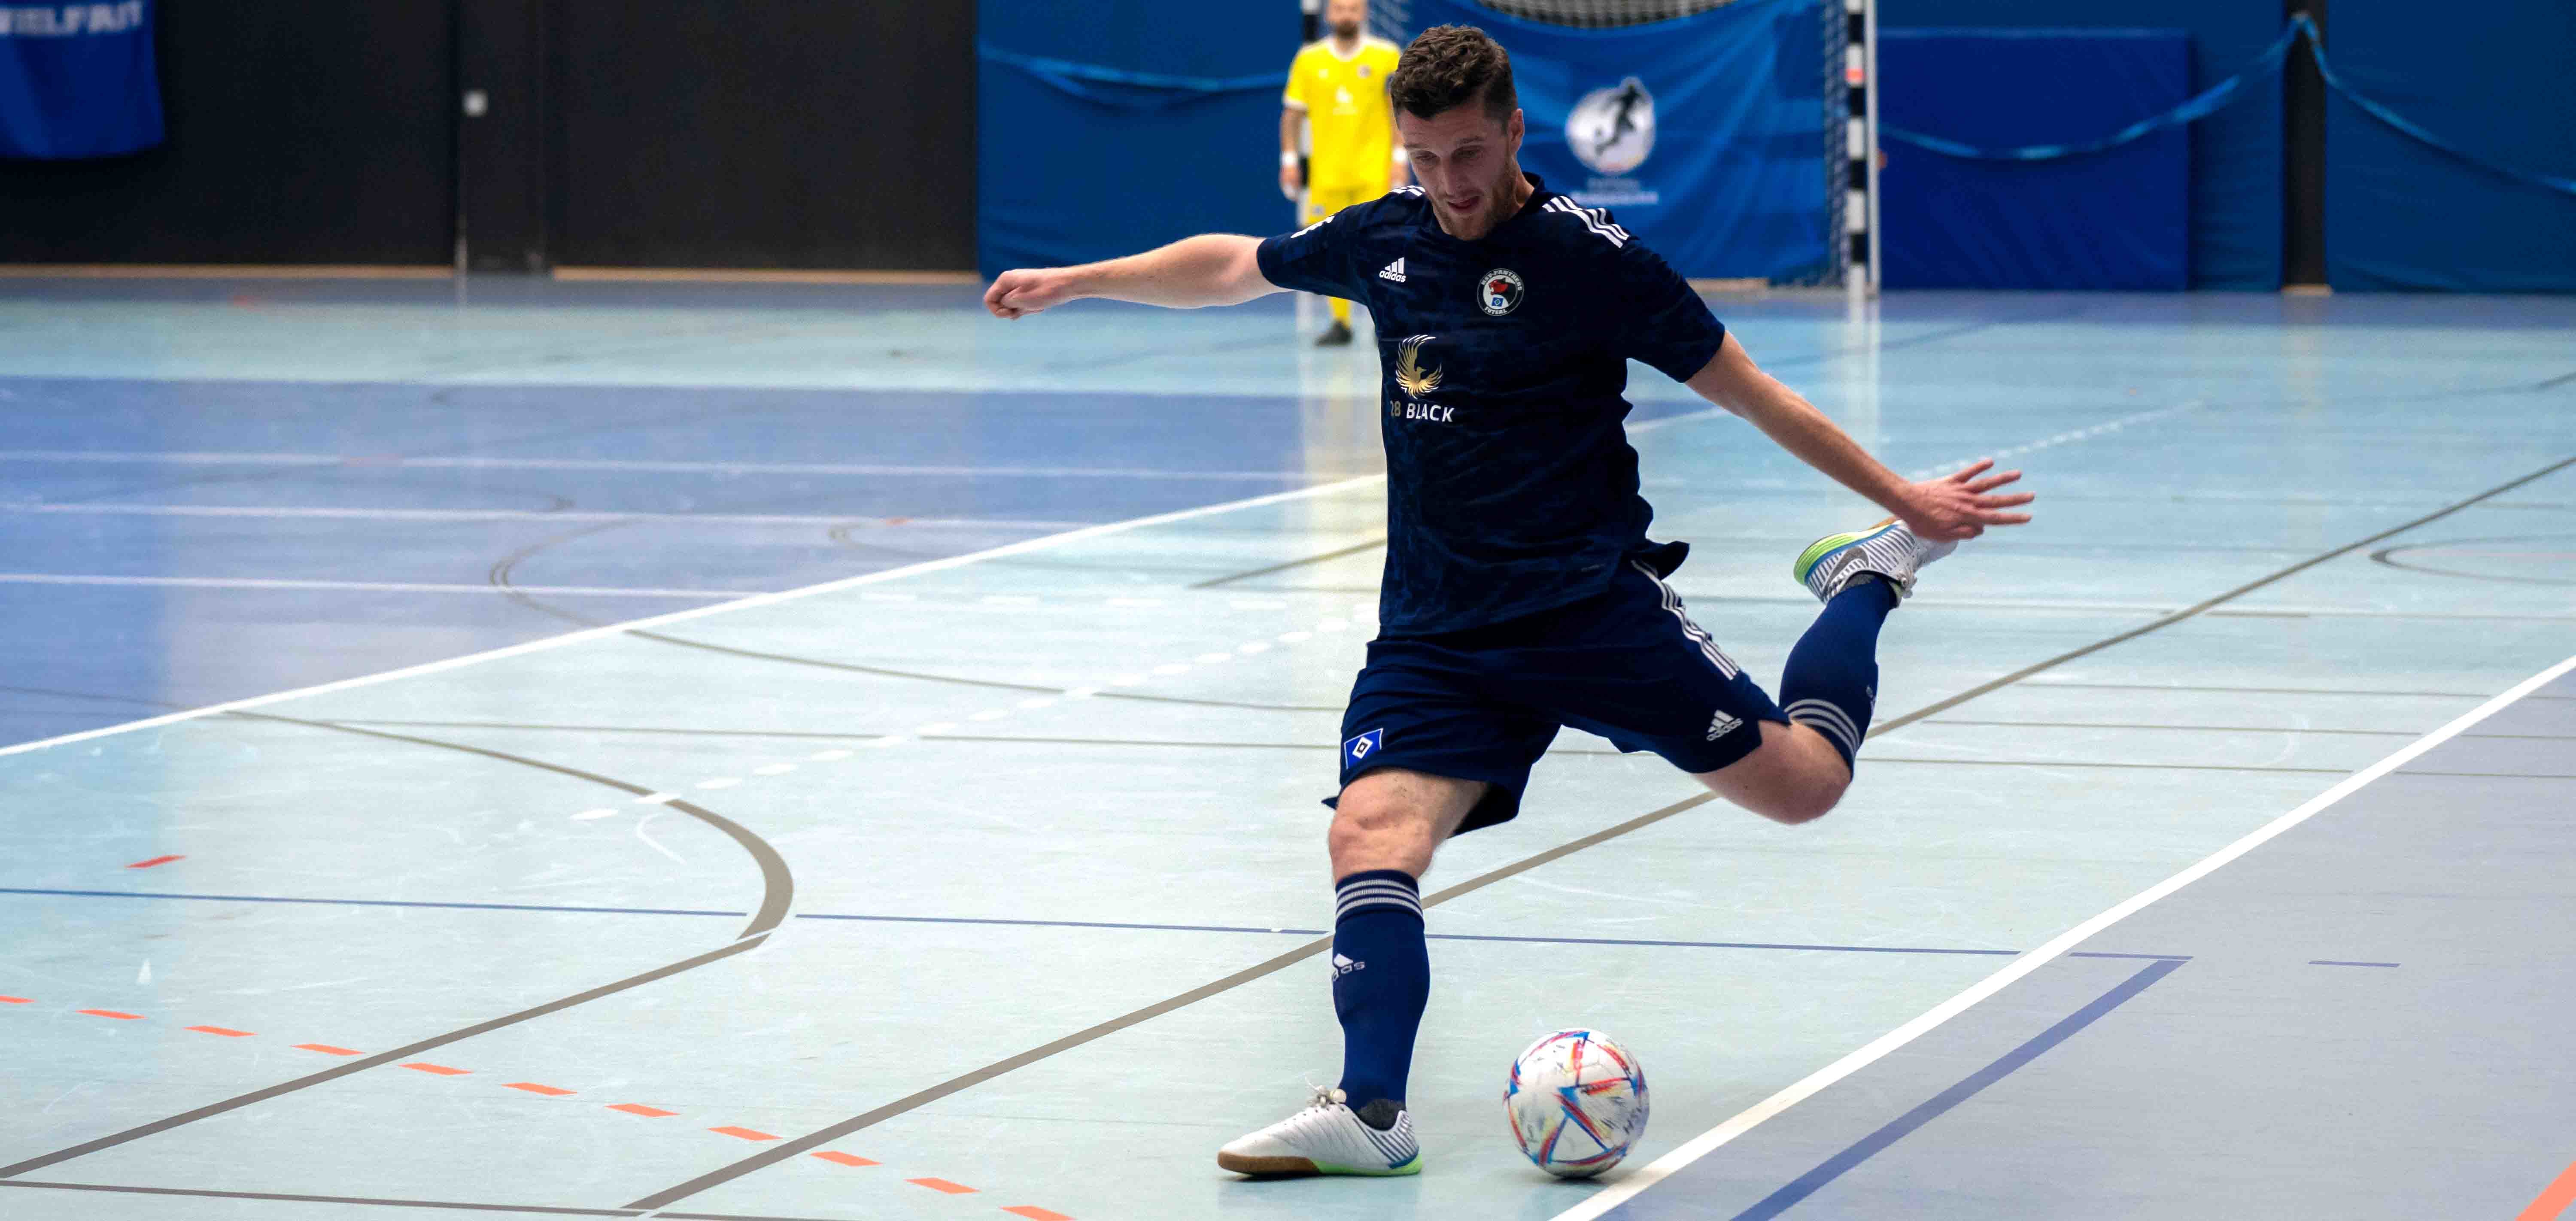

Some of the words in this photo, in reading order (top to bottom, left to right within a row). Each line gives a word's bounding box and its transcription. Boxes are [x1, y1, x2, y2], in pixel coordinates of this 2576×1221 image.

[1379, 270, 1406, 282] adidas
[1485, 307, 1507, 315] FUTSAL
[1406, 403, 1454, 422] BLACK
[1706, 718, 1744, 741] adidas
